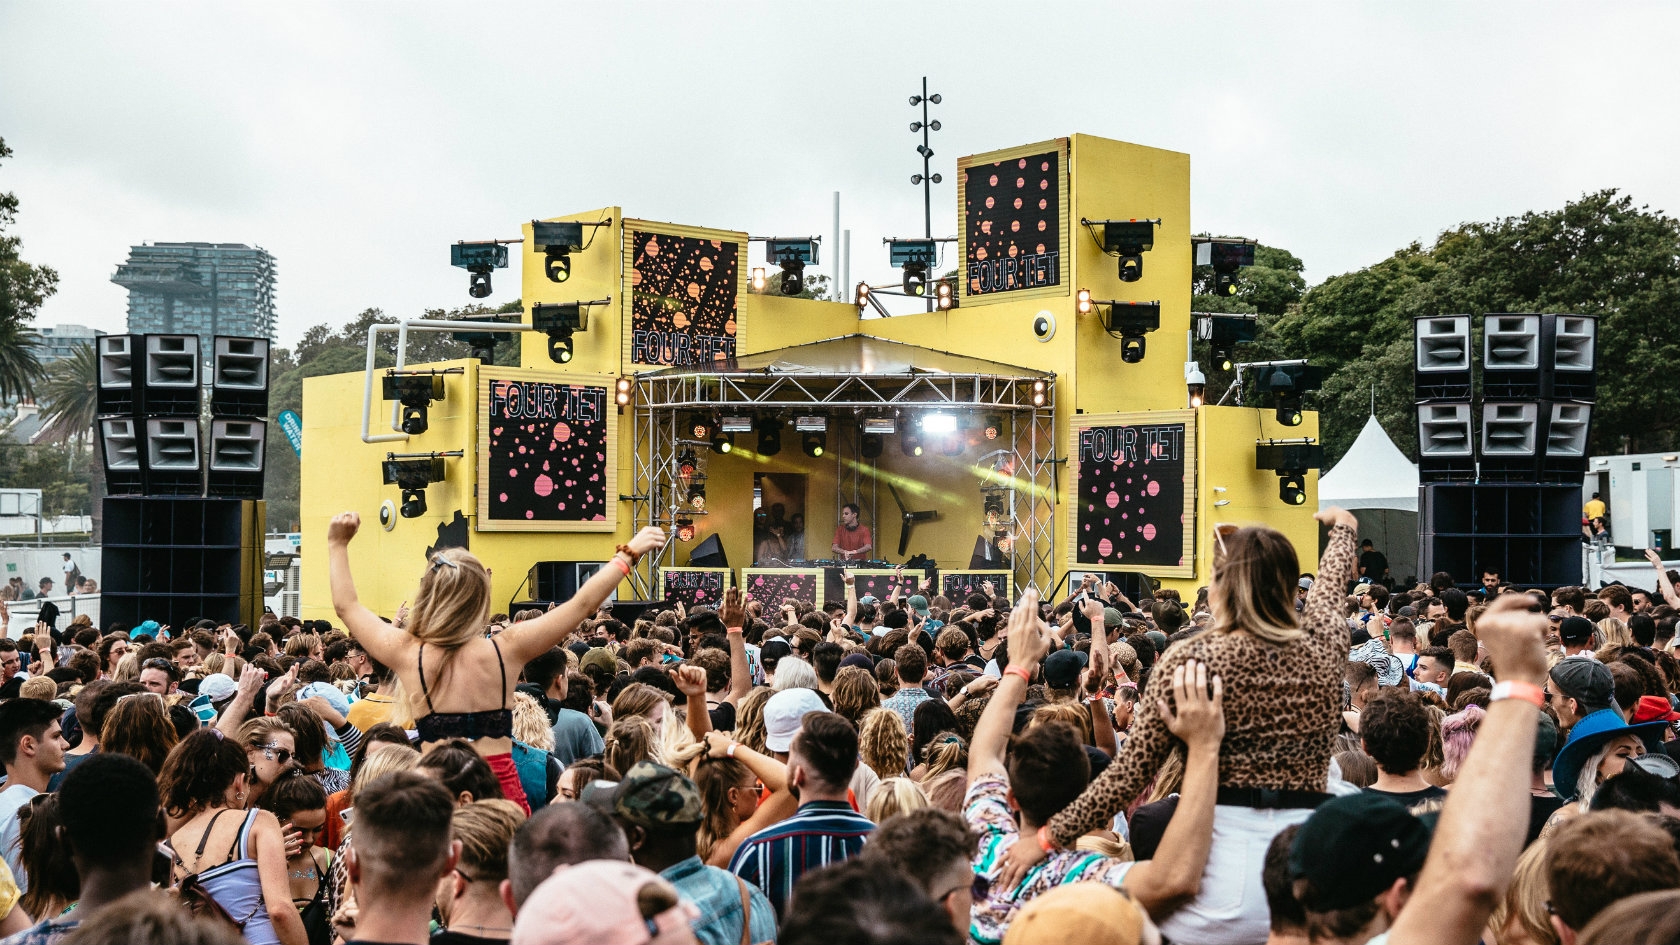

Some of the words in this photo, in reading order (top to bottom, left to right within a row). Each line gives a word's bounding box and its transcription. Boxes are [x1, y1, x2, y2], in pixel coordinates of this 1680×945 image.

[967, 257, 1018, 294] FOUR
[1022, 251, 1058, 287] TET
[632, 329, 692, 365] FOUR
[696, 334, 736, 362] TET
[490, 382, 557, 419] FOUR
[562, 386, 606, 421] TET
[283, 422, 302, 451] WATER
[1080, 427, 1137, 462] FOUR
[1142, 425, 1184, 461] TET
[664, 571, 698, 589] FOUR
